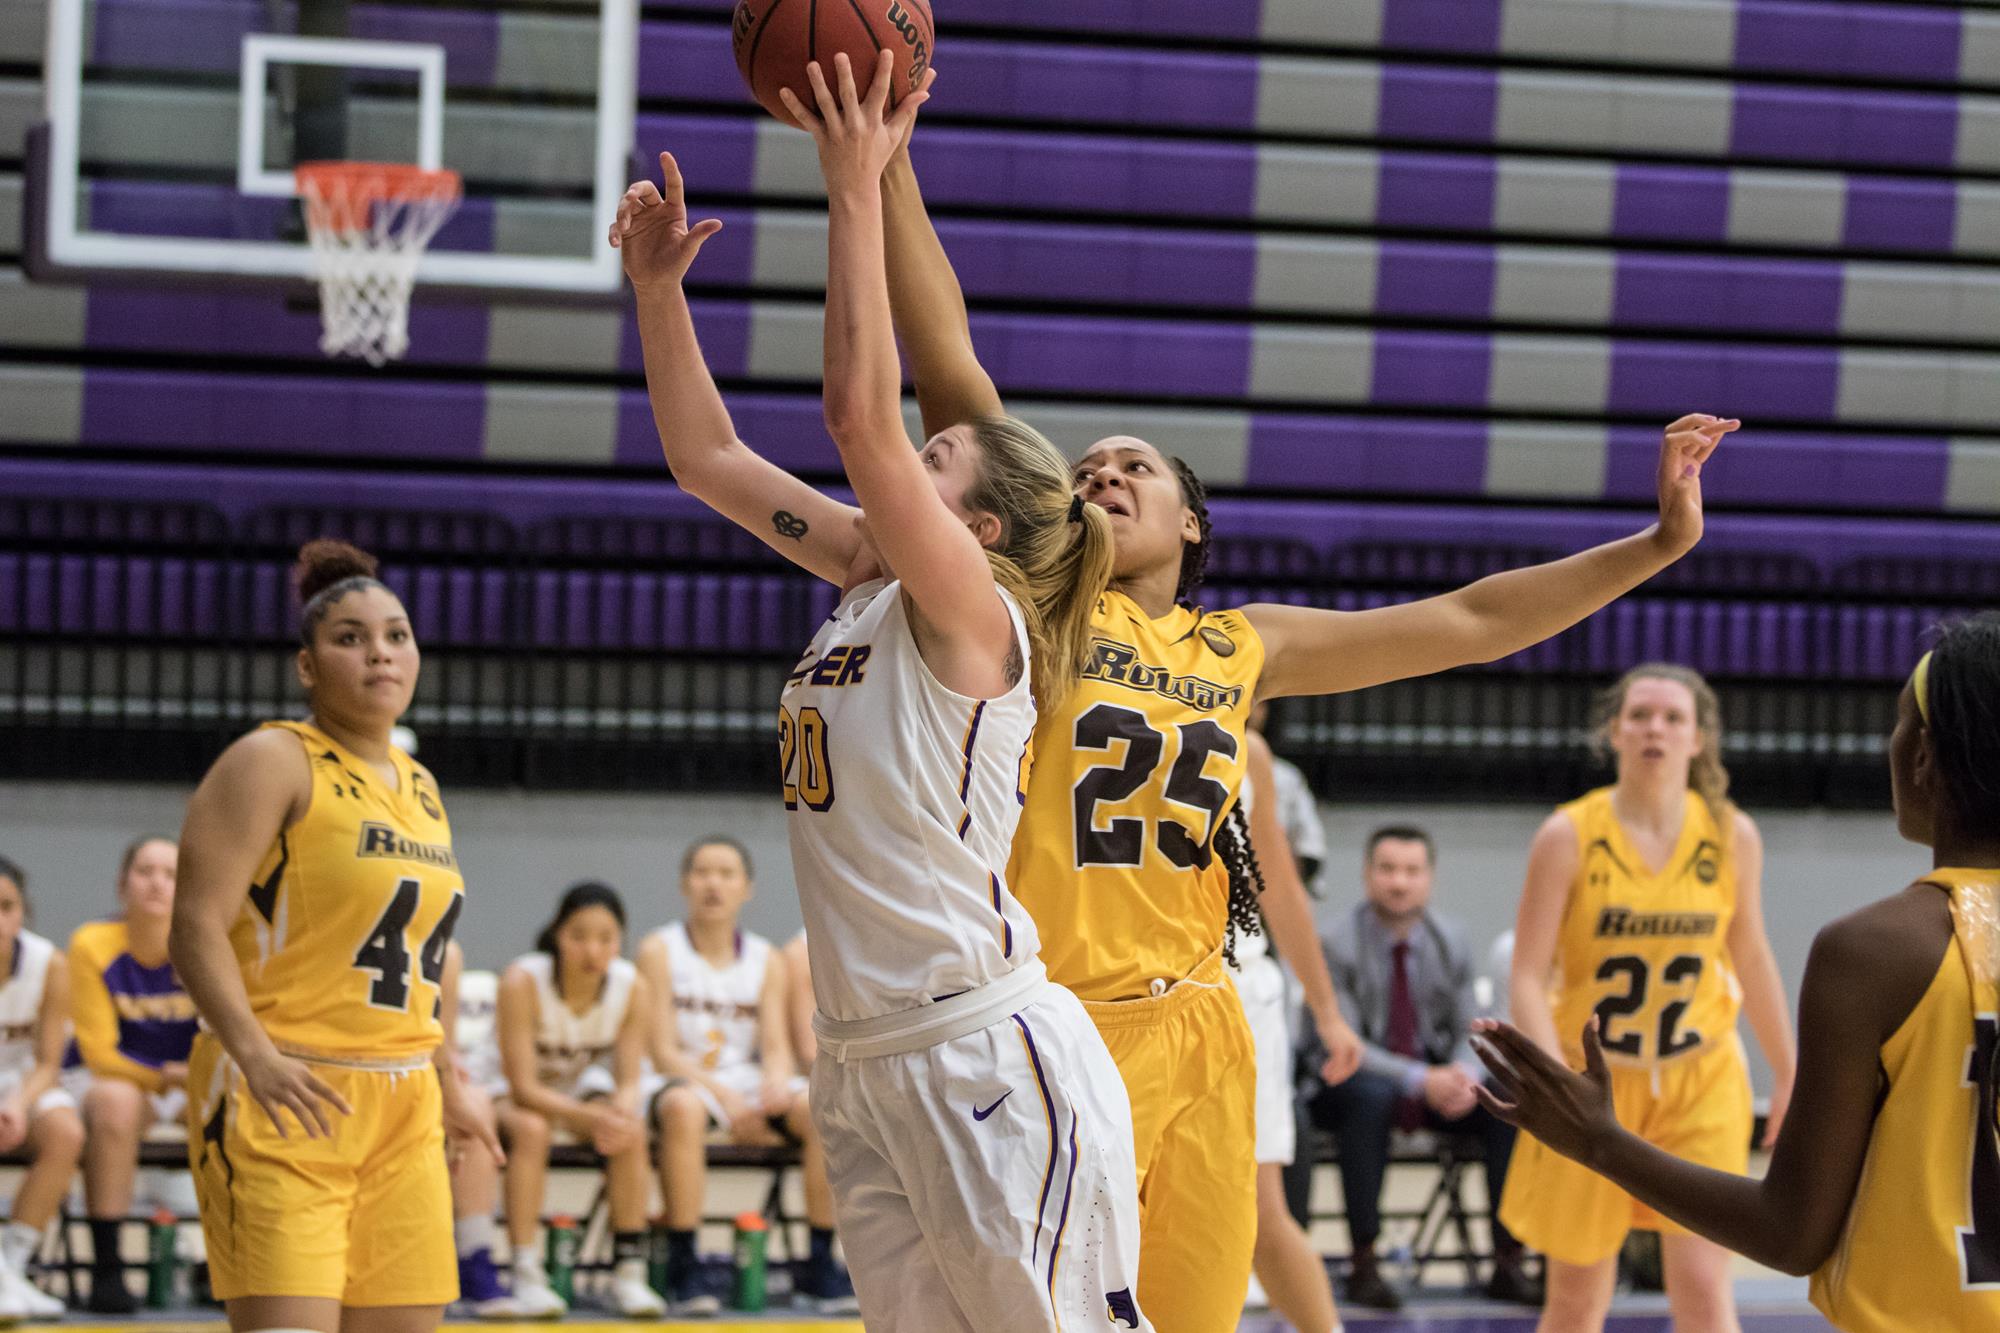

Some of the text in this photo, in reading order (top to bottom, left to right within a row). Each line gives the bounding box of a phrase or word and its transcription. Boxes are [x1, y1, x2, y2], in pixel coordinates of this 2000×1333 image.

[1083, 637, 1243, 712] Rowan
[778, 704, 835, 812] 20
[1072, 701, 1237, 871] 25
[352, 877, 464, 1022] 44
[1595, 955, 1703, 1058] 22
